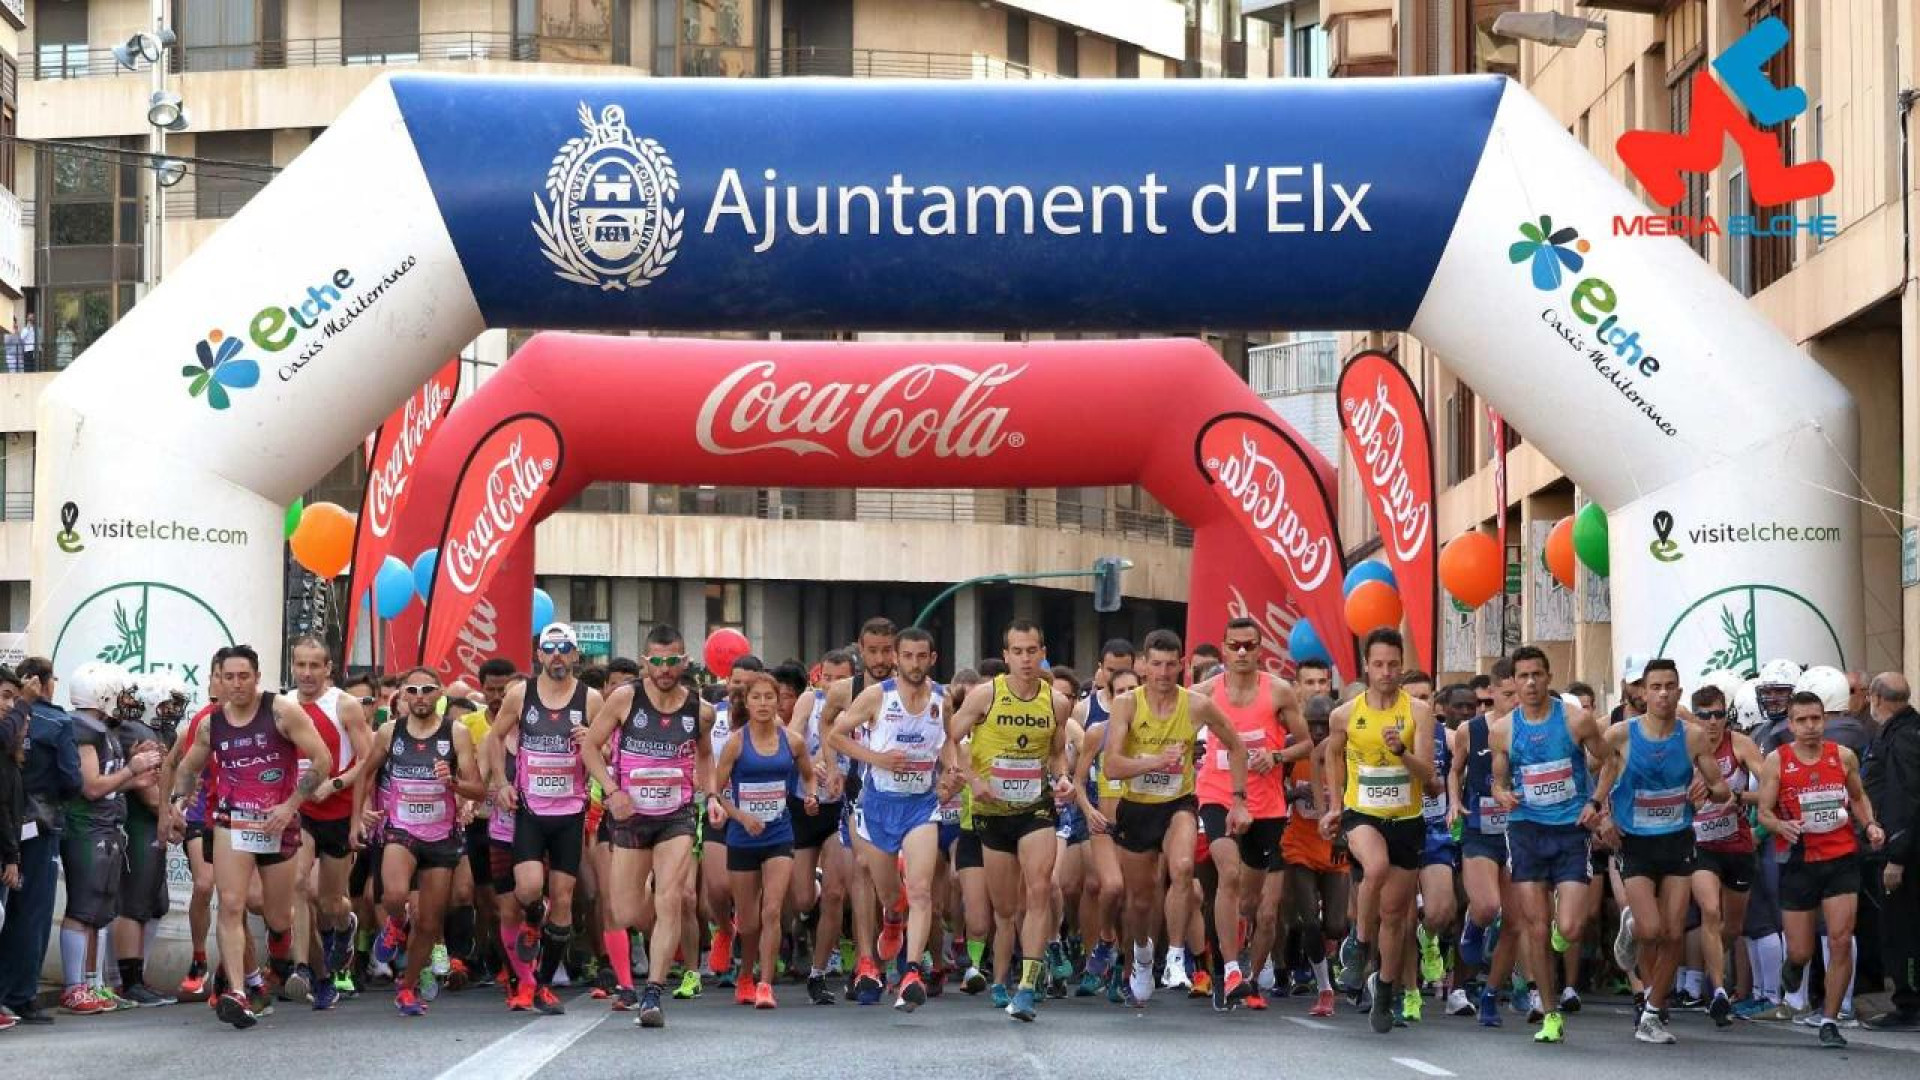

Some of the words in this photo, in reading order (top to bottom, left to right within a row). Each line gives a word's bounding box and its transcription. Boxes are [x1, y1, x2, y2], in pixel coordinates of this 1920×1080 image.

[703, 167, 1168, 252] Ajuntament
[1541, 308, 1585, 352] Oasis
[278, 341, 324, 382] Oasis
[91, 520, 248, 546] visitelche.com
[1689, 522, 1841, 544] visitelche.com
[997, 713, 1049, 728] mobel
[536, 776, 566, 787] 0020
[1003, 779, 1030, 790] 0017
[1534, 781, 1566, 796] 0092
[1367, 786, 1399, 798] 0549
[409, 803, 434, 814] 0021
[1701, 816, 1730, 832] 0048
[1814, 811, 1838, 823] 0241
